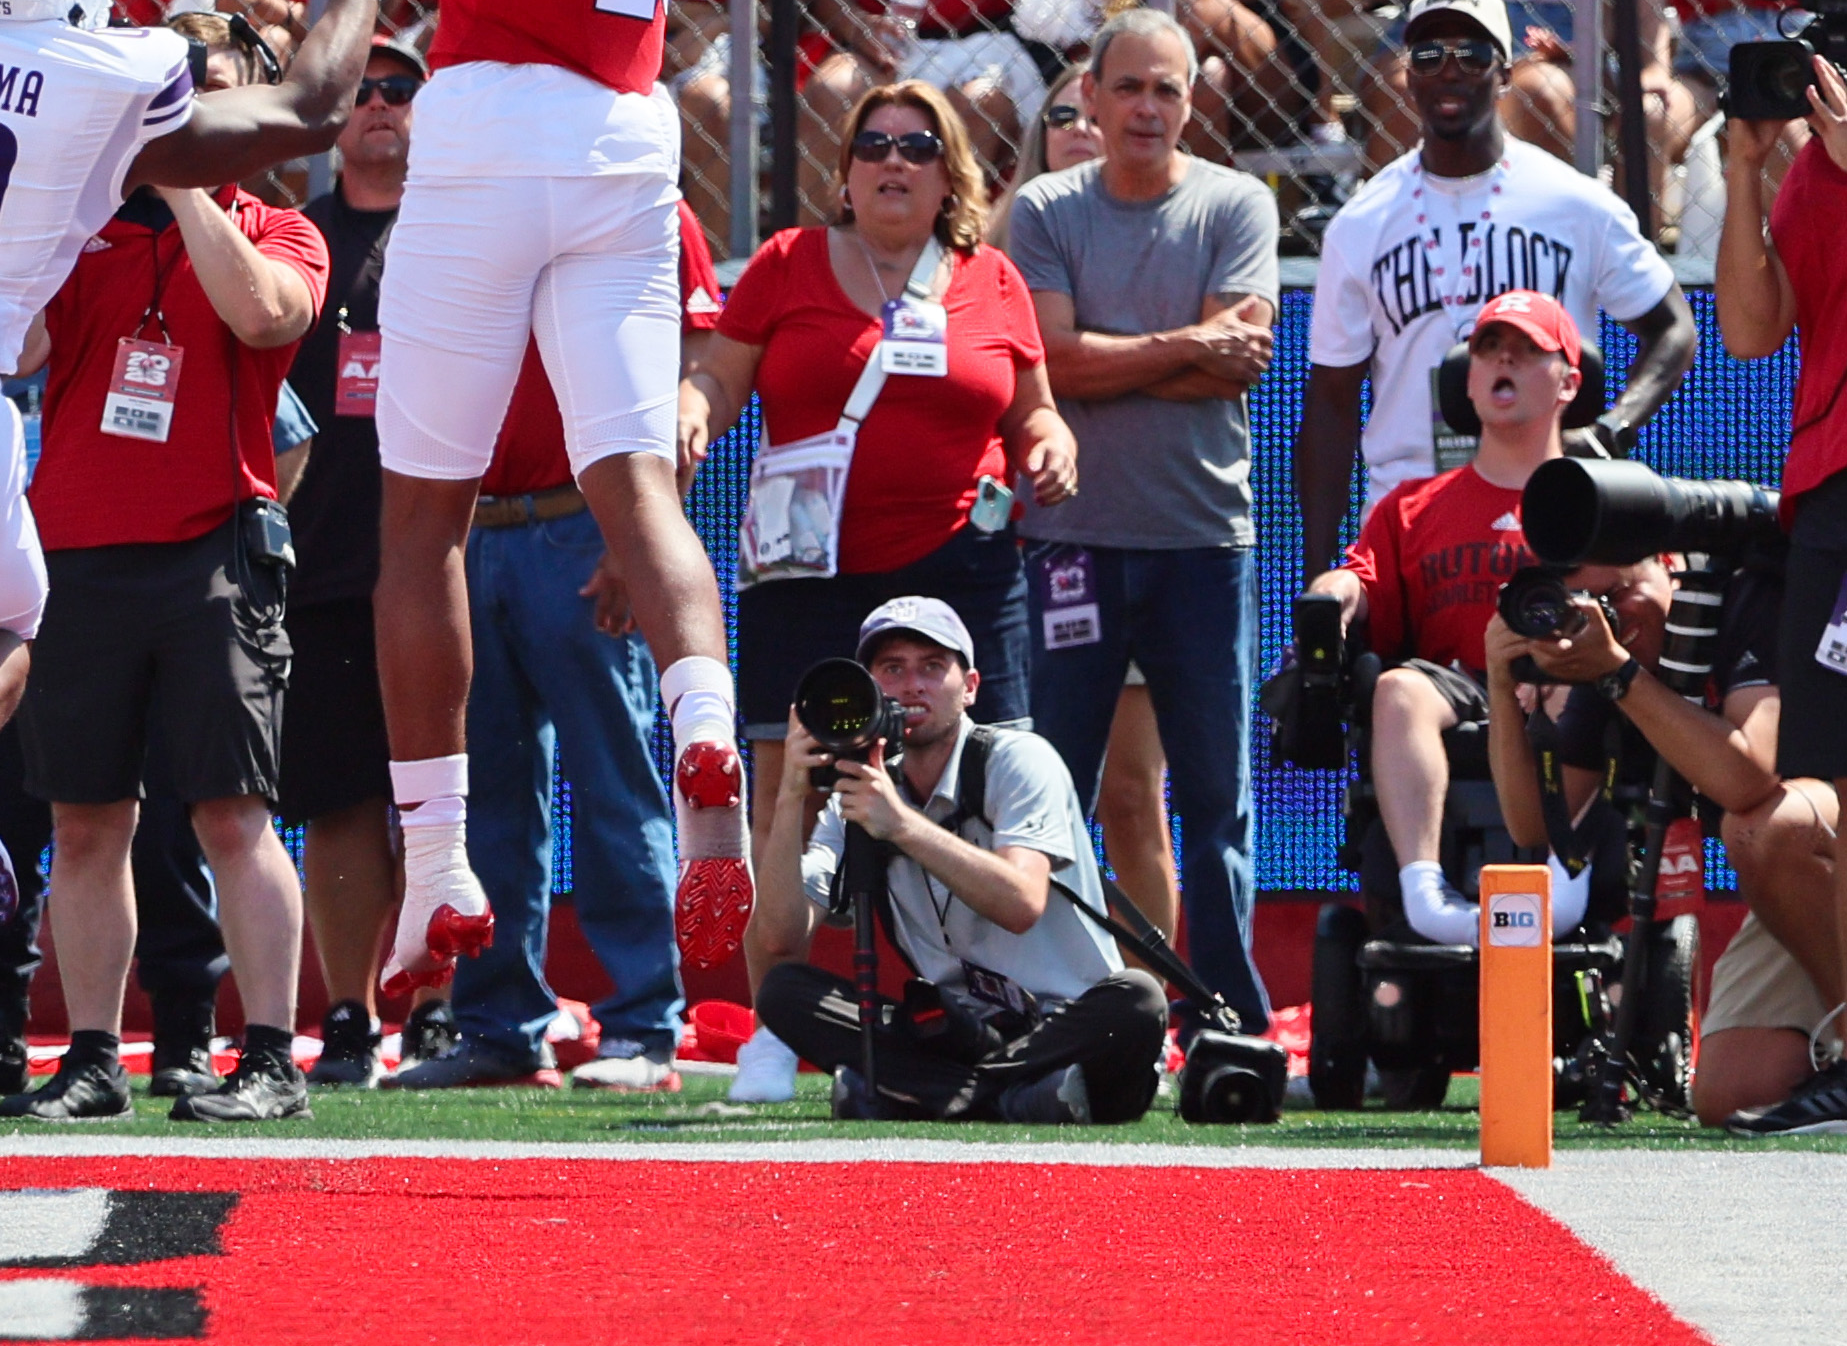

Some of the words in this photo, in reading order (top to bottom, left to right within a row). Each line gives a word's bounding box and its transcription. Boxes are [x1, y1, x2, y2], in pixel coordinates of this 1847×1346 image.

[1371, 227, 1442, 335] THE
[1455, 221, 1574, 310] BLOCK
[1494, 294, 1531, 314] R
[1493, 910, 1536, 929] BIG
